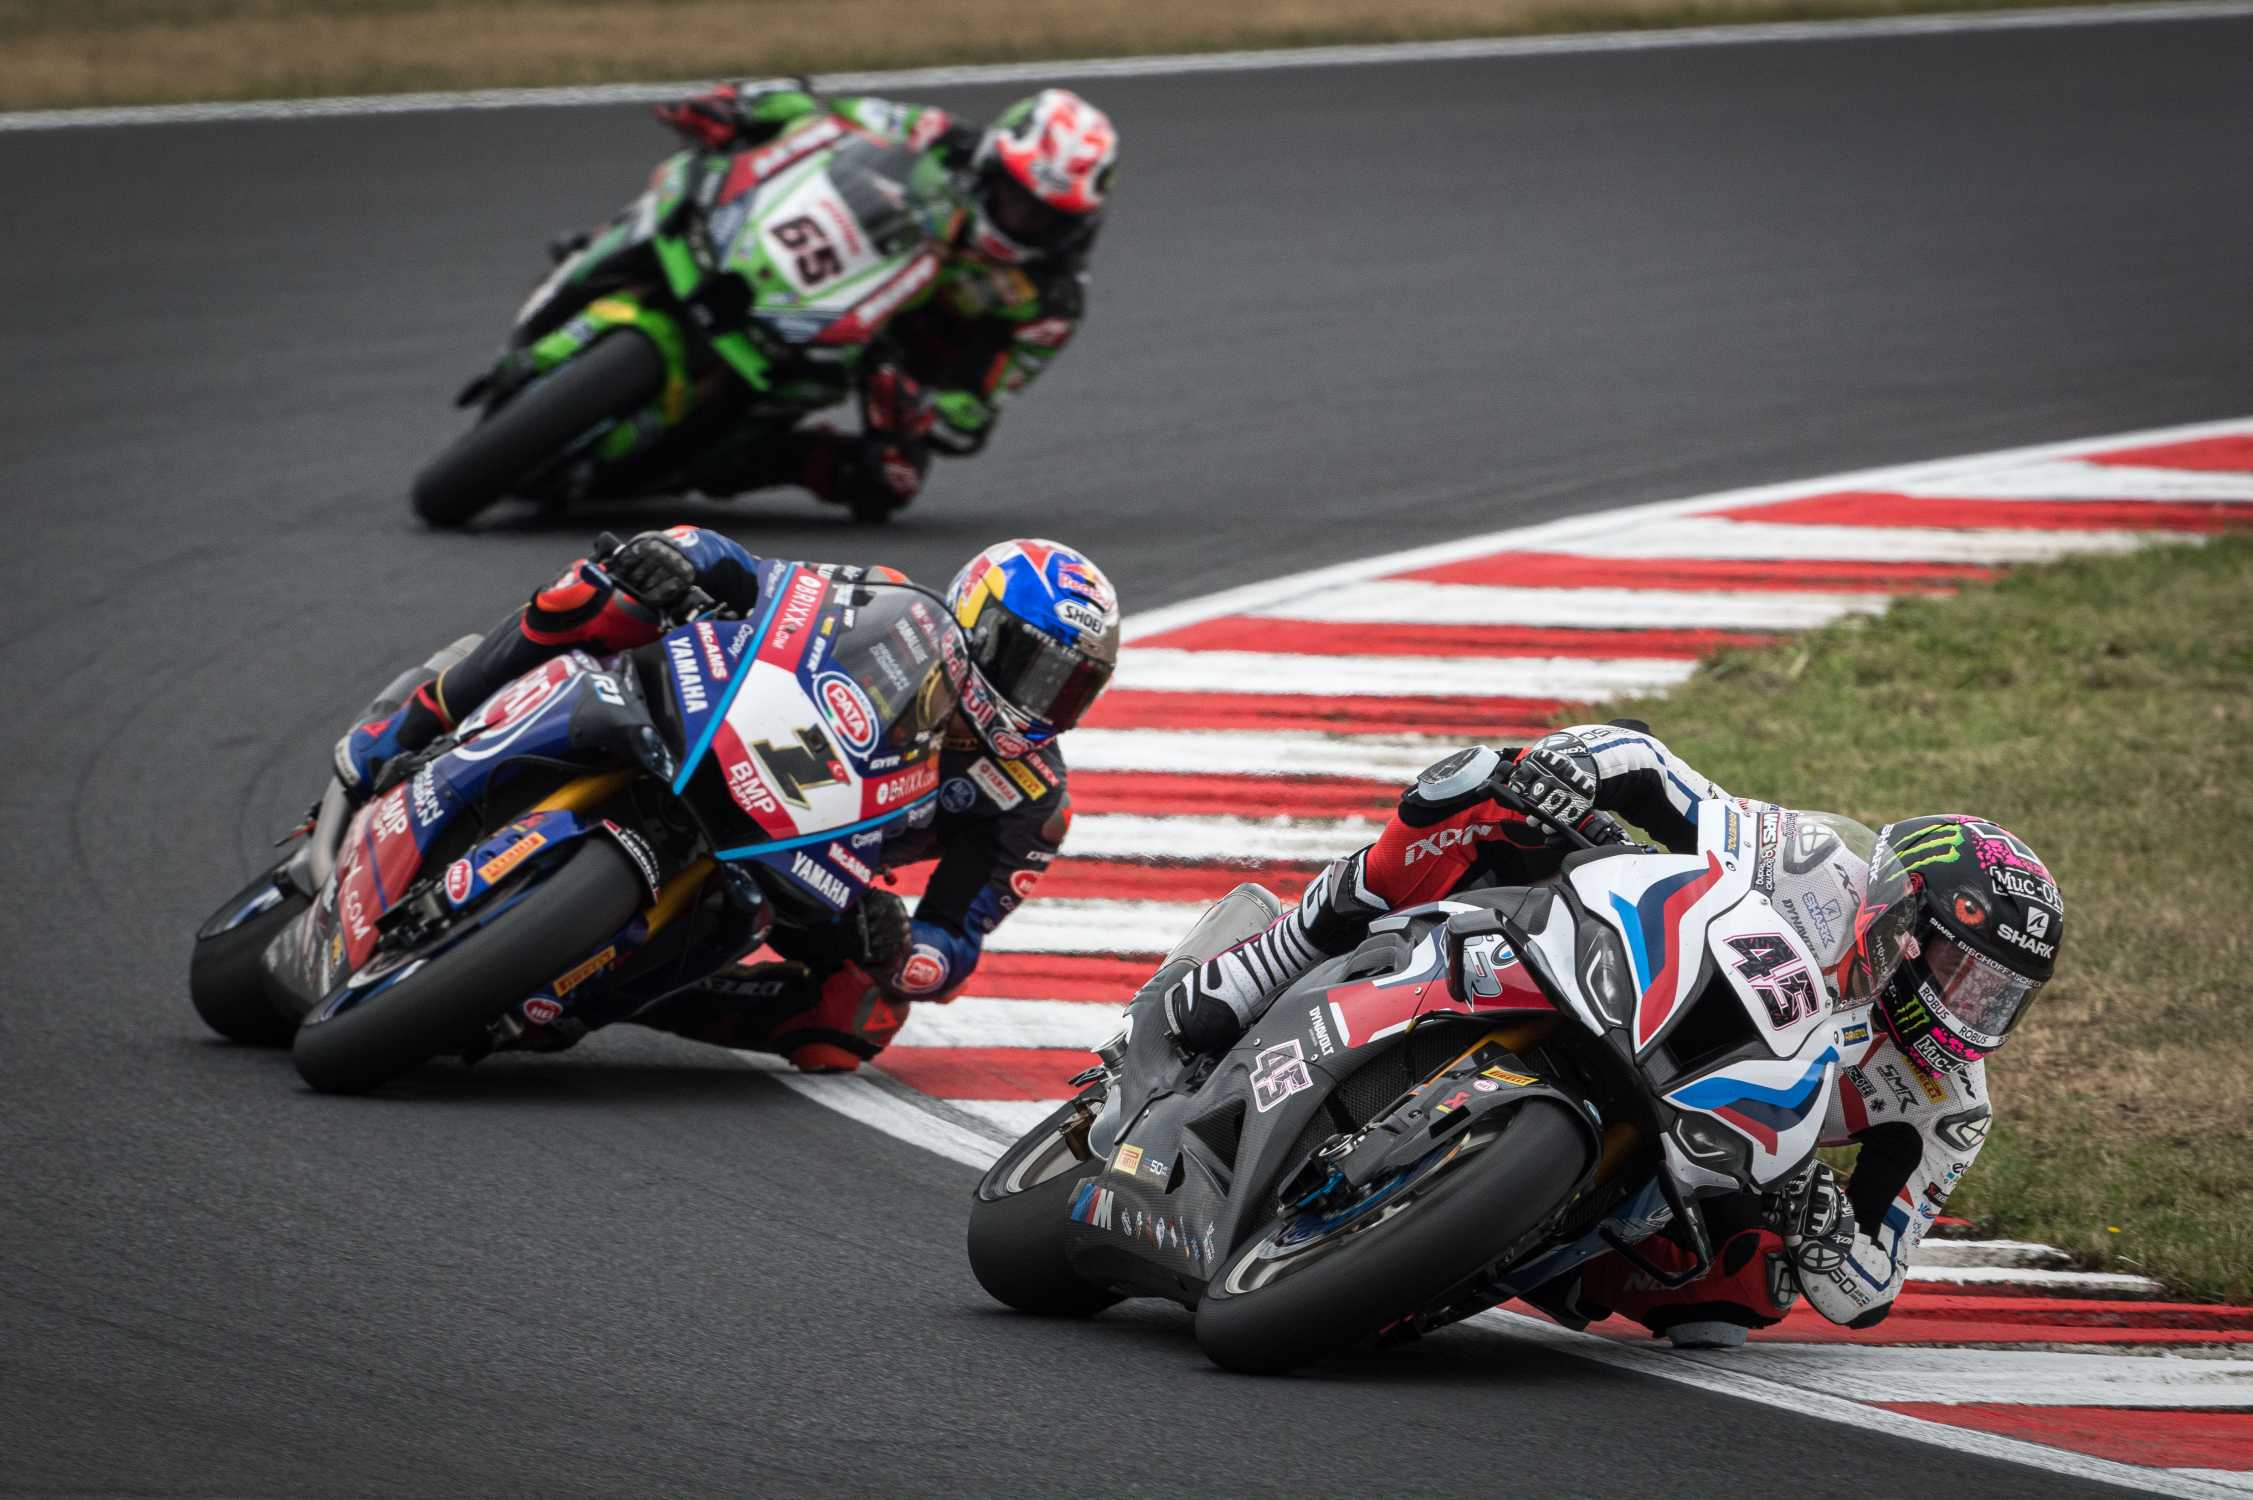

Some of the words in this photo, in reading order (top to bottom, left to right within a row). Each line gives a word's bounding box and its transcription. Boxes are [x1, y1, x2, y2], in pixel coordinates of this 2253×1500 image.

[770, 215, 846, 288] 65
[668, 636, 709, 714] YAMAHA
[696, 622, 728, 680] McAMS
[830, 687, 868, 737] PATA
[729, 761, 777, 814] BMP
[751, 723, 842, 811] 1
[791, 851, 850, 908] YAMAHA
[1801, 891, 1836, 949] SHARK
[1996, 922, 2055, 959] SHARK
[1723, 932, 1821, 1031] 45
[1920, 986, 1950, 1022] ROBUS
[1308, 1005, 1335, 1057] DYNAVOLT
[1959, 1026, 1990, 1046] ROBUS
